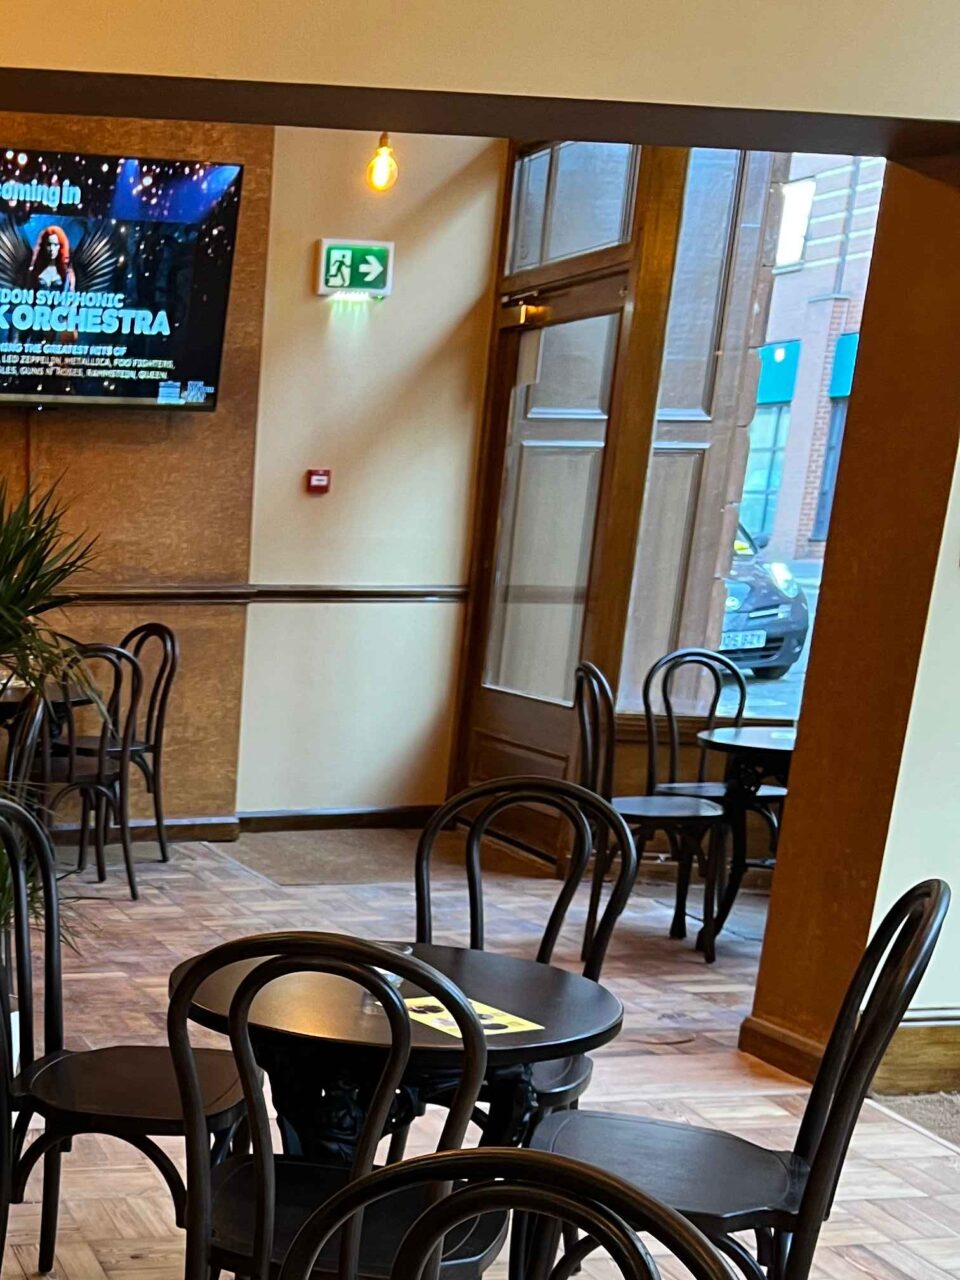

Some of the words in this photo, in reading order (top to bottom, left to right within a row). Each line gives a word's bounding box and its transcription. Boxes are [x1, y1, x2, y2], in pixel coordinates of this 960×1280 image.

[36, 290, 125, 308] SYMPHONIC
[12, 304, 170, 335] ORCHESTRA
[24, 343, 42, 353] THE
[43, 344, 89, 355] GREATEST
[90, 345, 113, 355] HITS
[113, 346, 127, 356] OF
[2, 354, 19, 363] LED
[113, 358, 132, 367] FOO
[20, 366, 44, 376] GUNS
